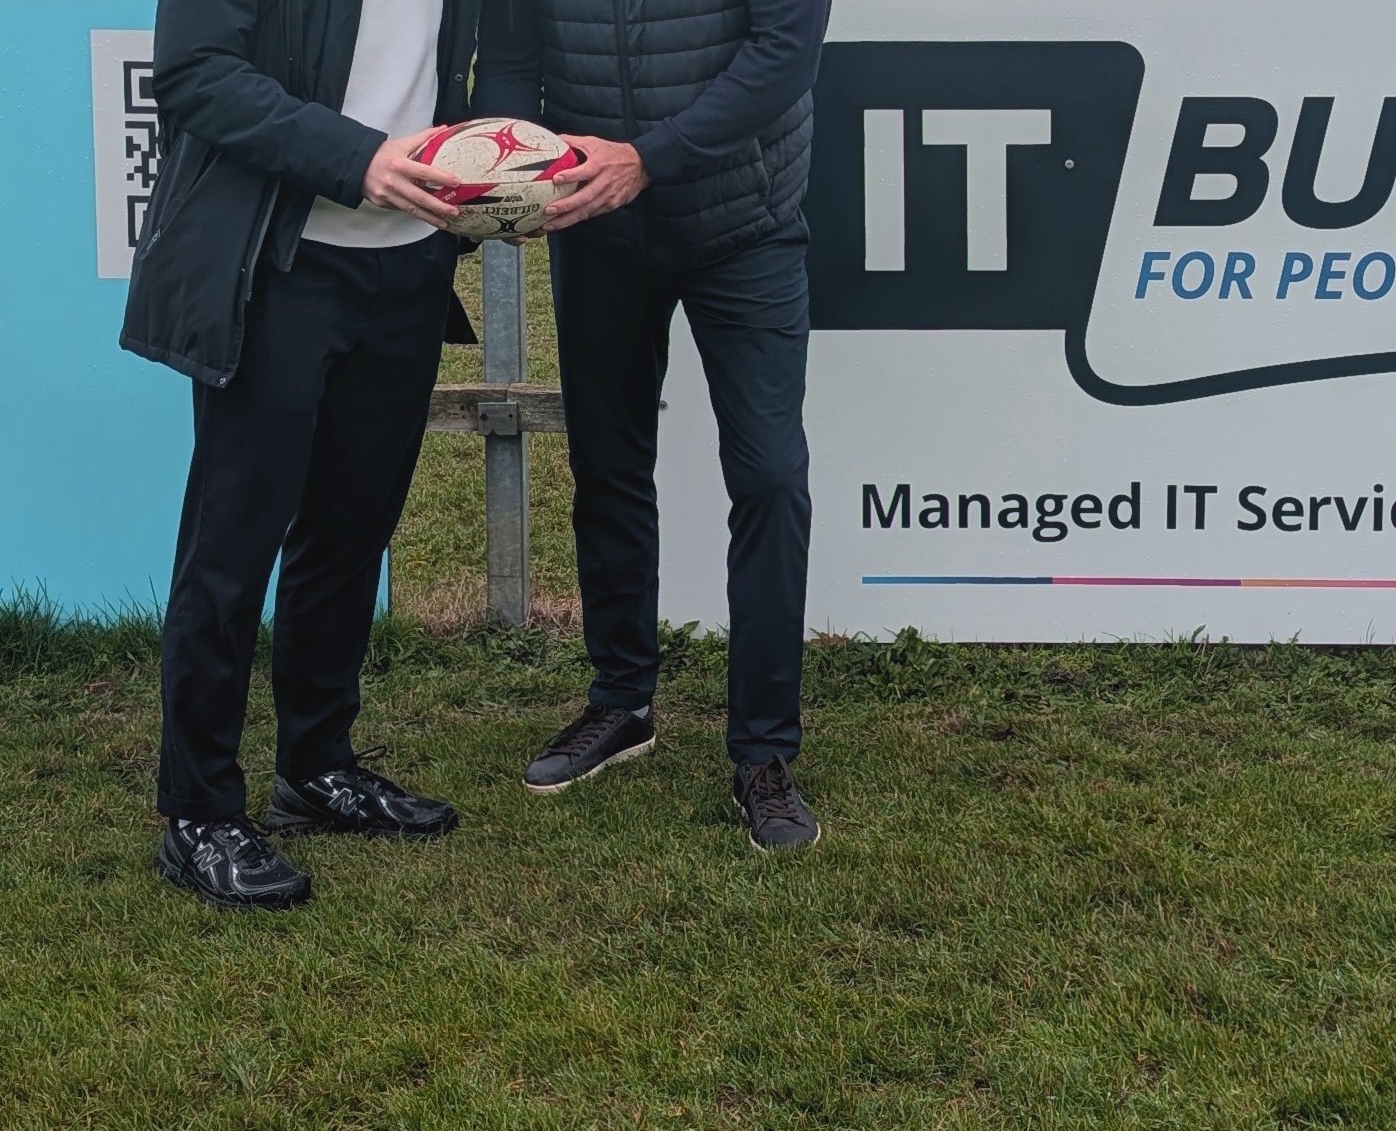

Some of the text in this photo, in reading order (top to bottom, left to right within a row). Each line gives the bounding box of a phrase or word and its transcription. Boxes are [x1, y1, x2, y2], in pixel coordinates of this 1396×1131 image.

[482, 203, 541, 216] GILBERT
[864, 109, 1051, 271] IT
[1135, 251, 1255, 299] FOR
[863, 482, 1140, 542] Managed
[1167, 485, 1217, 529] IT
[192, 843, 222, 872] N
